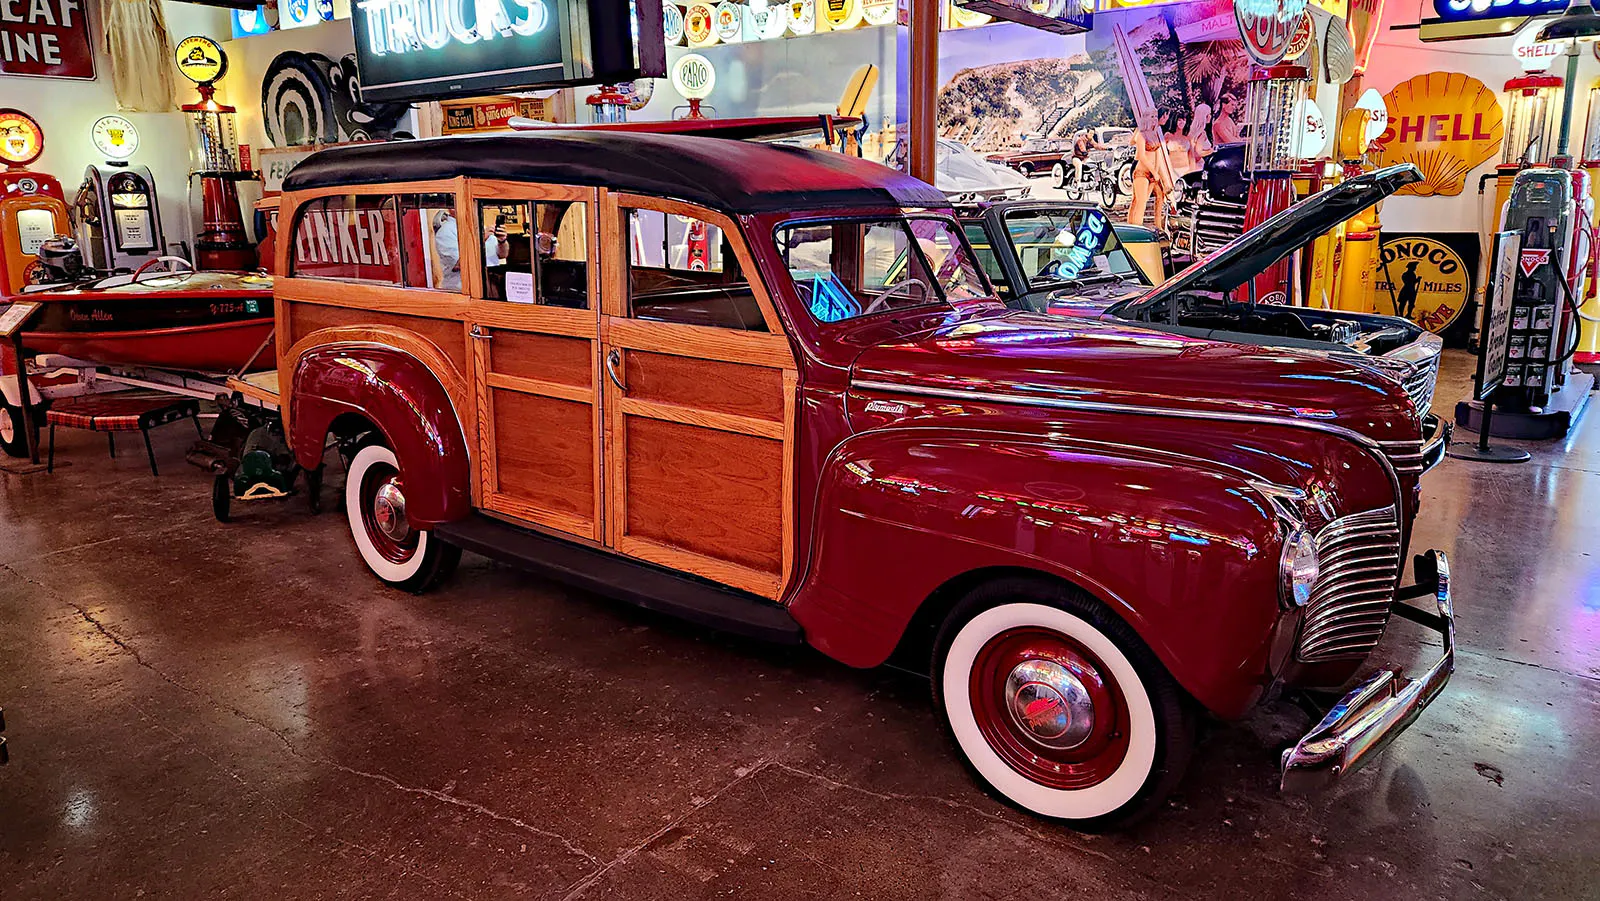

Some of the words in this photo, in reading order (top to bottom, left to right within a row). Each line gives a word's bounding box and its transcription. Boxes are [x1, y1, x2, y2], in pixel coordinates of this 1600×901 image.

[357, 0, 549, 56] TRUCKS
[1518, 43, 1557, 58] SHELL
[682, 61, 707, 88] PARCO
[500, 105, 516, 118] COAL
[1377, 112, 1491, 144] SHELL
[1423, 281, 1462, 293] MILES
